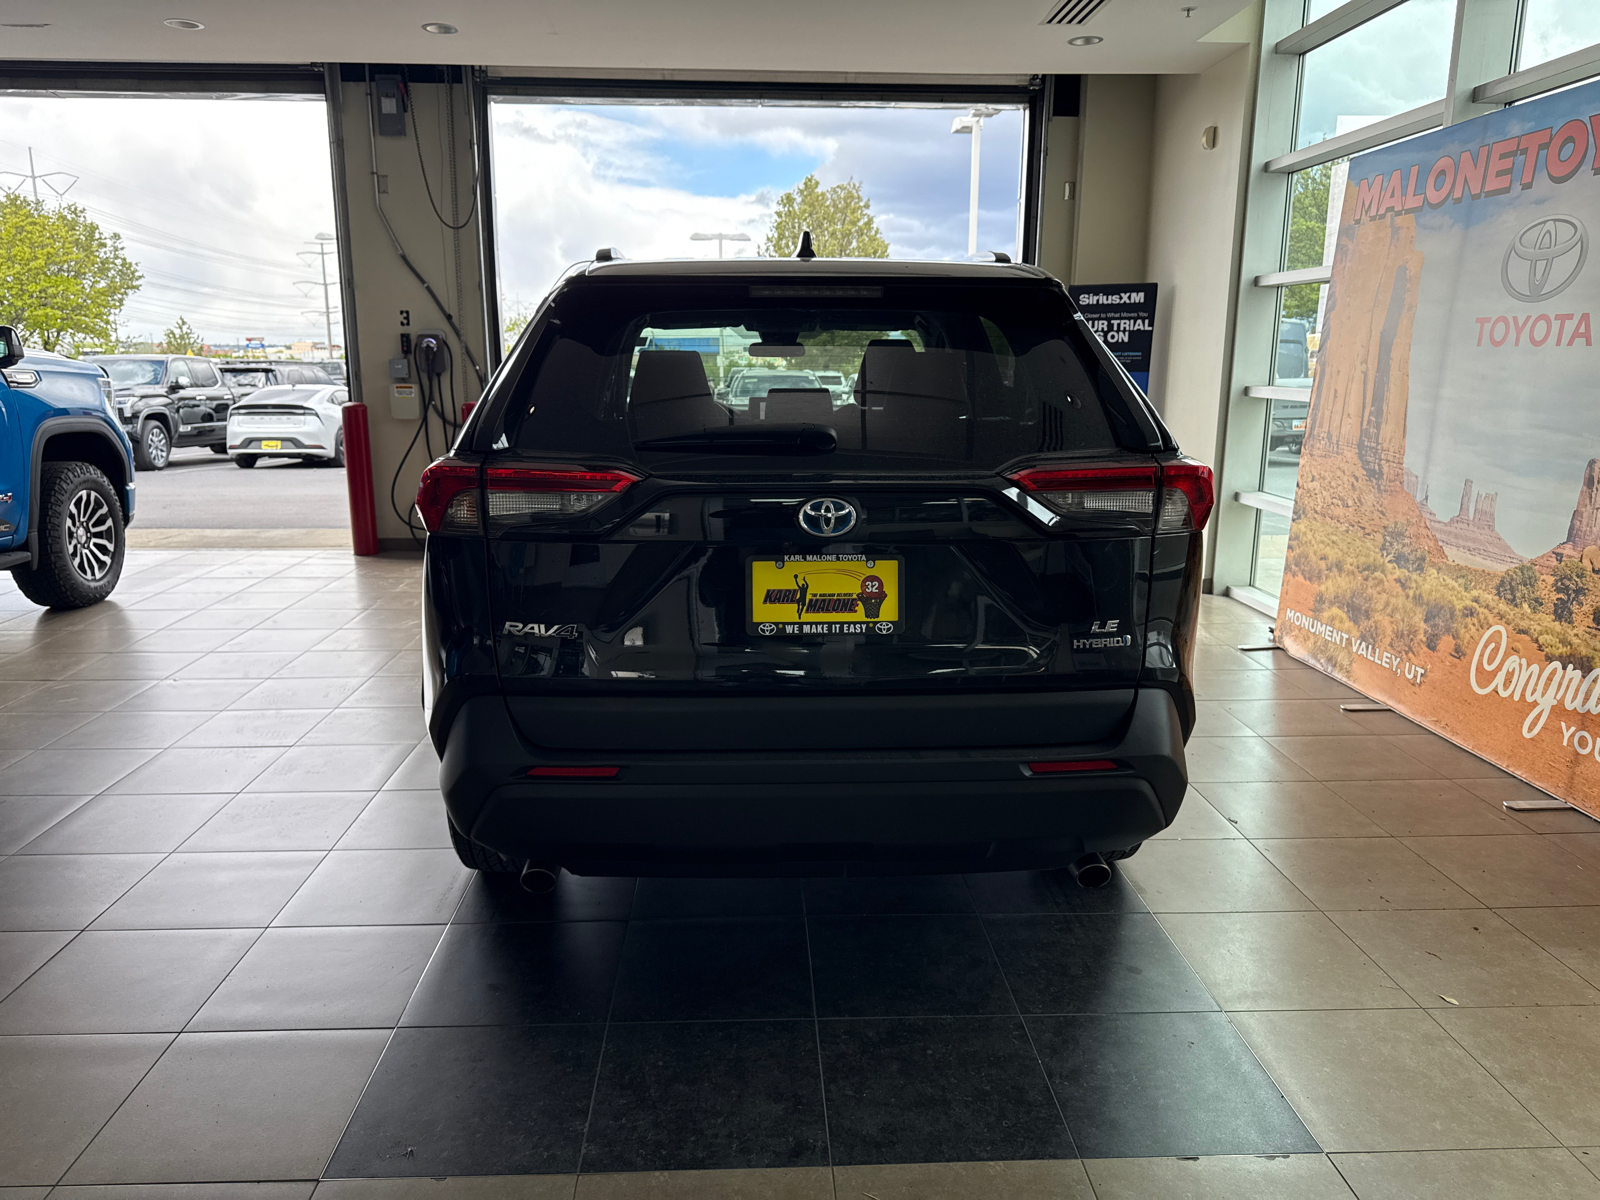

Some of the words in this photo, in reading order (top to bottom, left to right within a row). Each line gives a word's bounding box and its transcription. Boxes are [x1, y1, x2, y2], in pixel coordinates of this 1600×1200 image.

[1353, 113, 1600, 224] MALONETO
[1078, 292, 1145, 305] SiriusXM
[400, 310, 410, 326] 3
[1110, 319, 1153, 331] TRIAL
[1107, 331, 1129, 343] ON
[1475, 312, 1593, 348] TOYOTA
[865, 581, 879, 592] 32
[763, 589, 799, 604] KARL
[805, 598, 859, 614] MALONE
[502, 621, 578, 639] RAV4
[785, 624, 799, 633] WE
[803, 624, 829, 633] MAKE
[832, 624, 840, 633] IT
[843, 624, 867, 633] EASY
[1090, 619, 1120, 633] LE
[1073, 637, 1122, 648] HYBRID
[1285, 608, 1349, 648] MONUMENT
[1351, 637, 1401, 677] VALLEY,
[1404, 662, 1425, 684] UT
